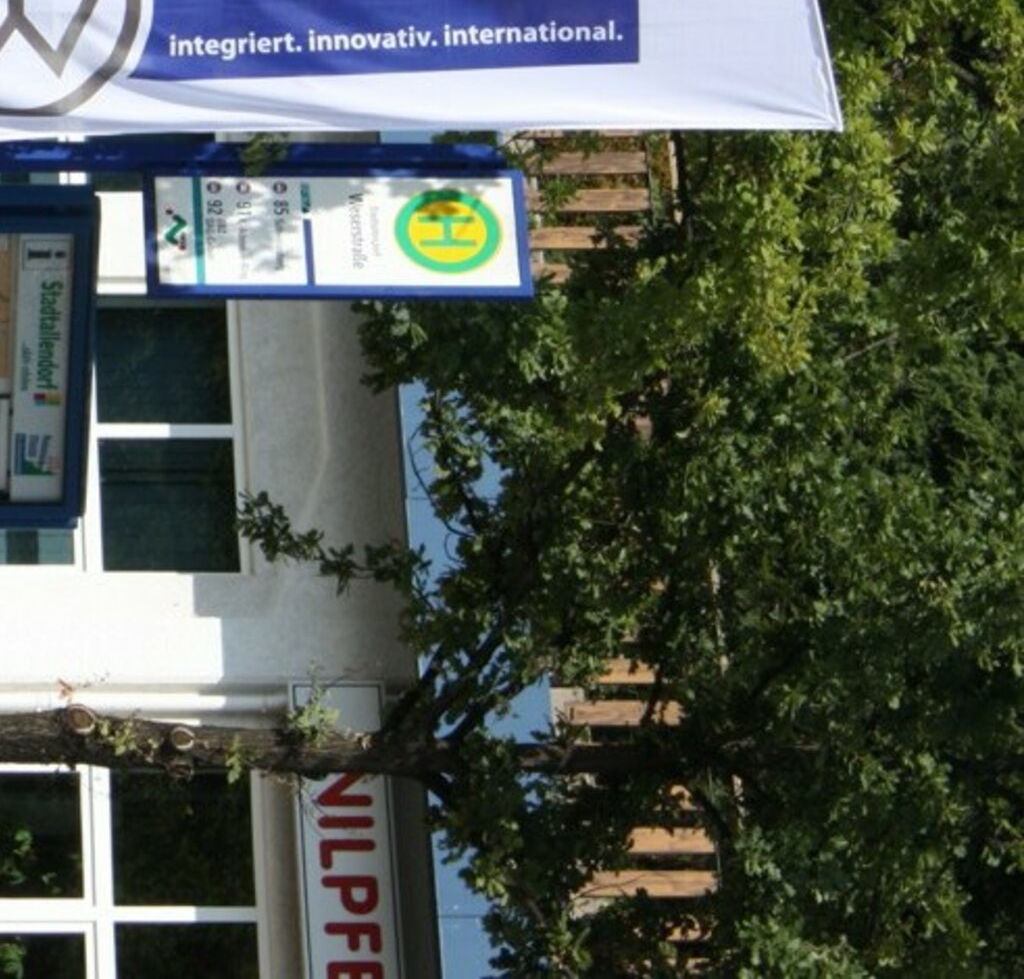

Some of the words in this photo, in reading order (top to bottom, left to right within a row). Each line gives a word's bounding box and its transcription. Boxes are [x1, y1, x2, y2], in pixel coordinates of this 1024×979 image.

[168, 31, 303, 62] integriert.
[307, 26, 439, 52] innovativ.
[443, 20, 624, 48] international.
[206, 199, 223, 216] 92
[236, 200, 252, 216] 91
[273, 199, 290, 216] 85
[348, 192, 369, 270] Weserstraße
[419, 215, 476, 247] H
[34, 280, 65, 391] Stadtallendorf
